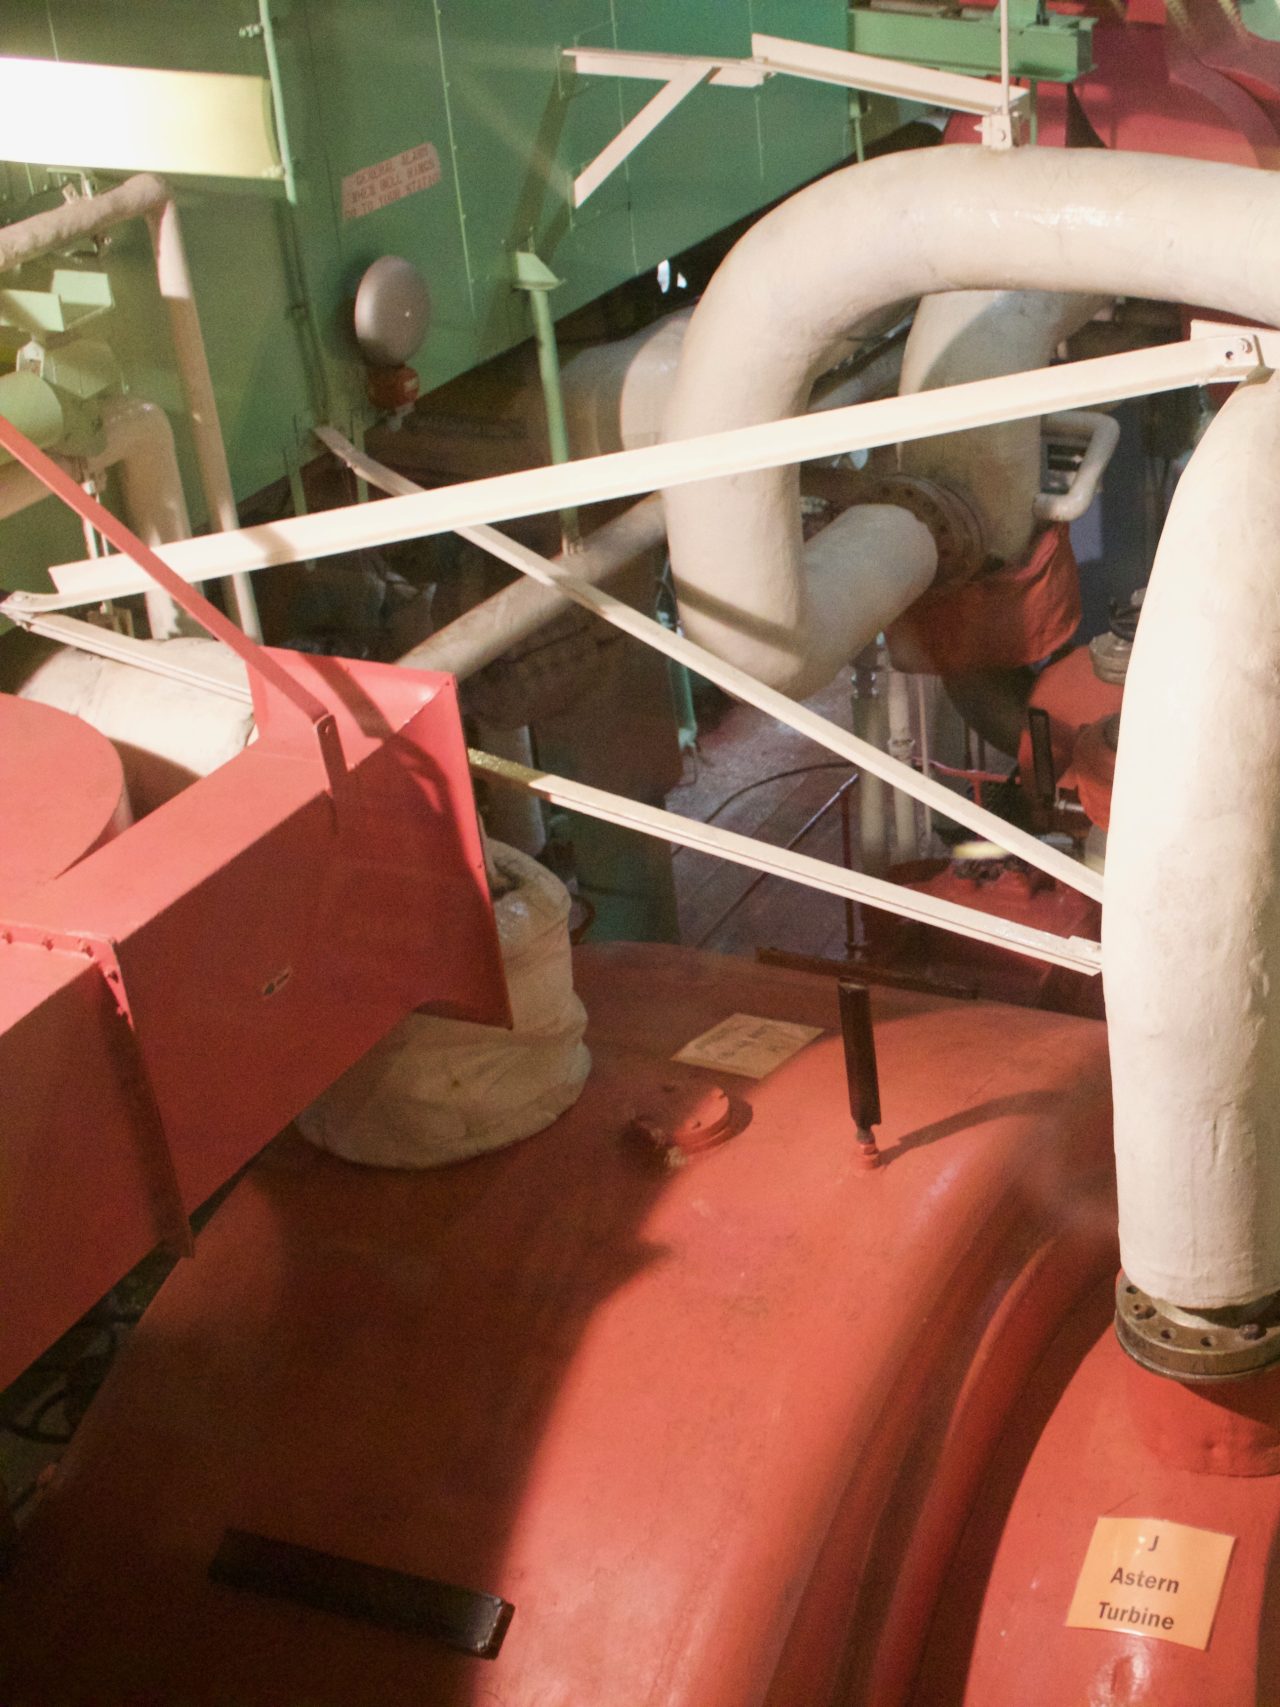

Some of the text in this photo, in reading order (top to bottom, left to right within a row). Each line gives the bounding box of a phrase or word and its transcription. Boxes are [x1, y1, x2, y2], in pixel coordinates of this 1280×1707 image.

[1148, 1535, 1159, 1552] J
[1110, 1567, 1180, 1594] Astern
[1098, 1601, 1175, 1631] Turbine
